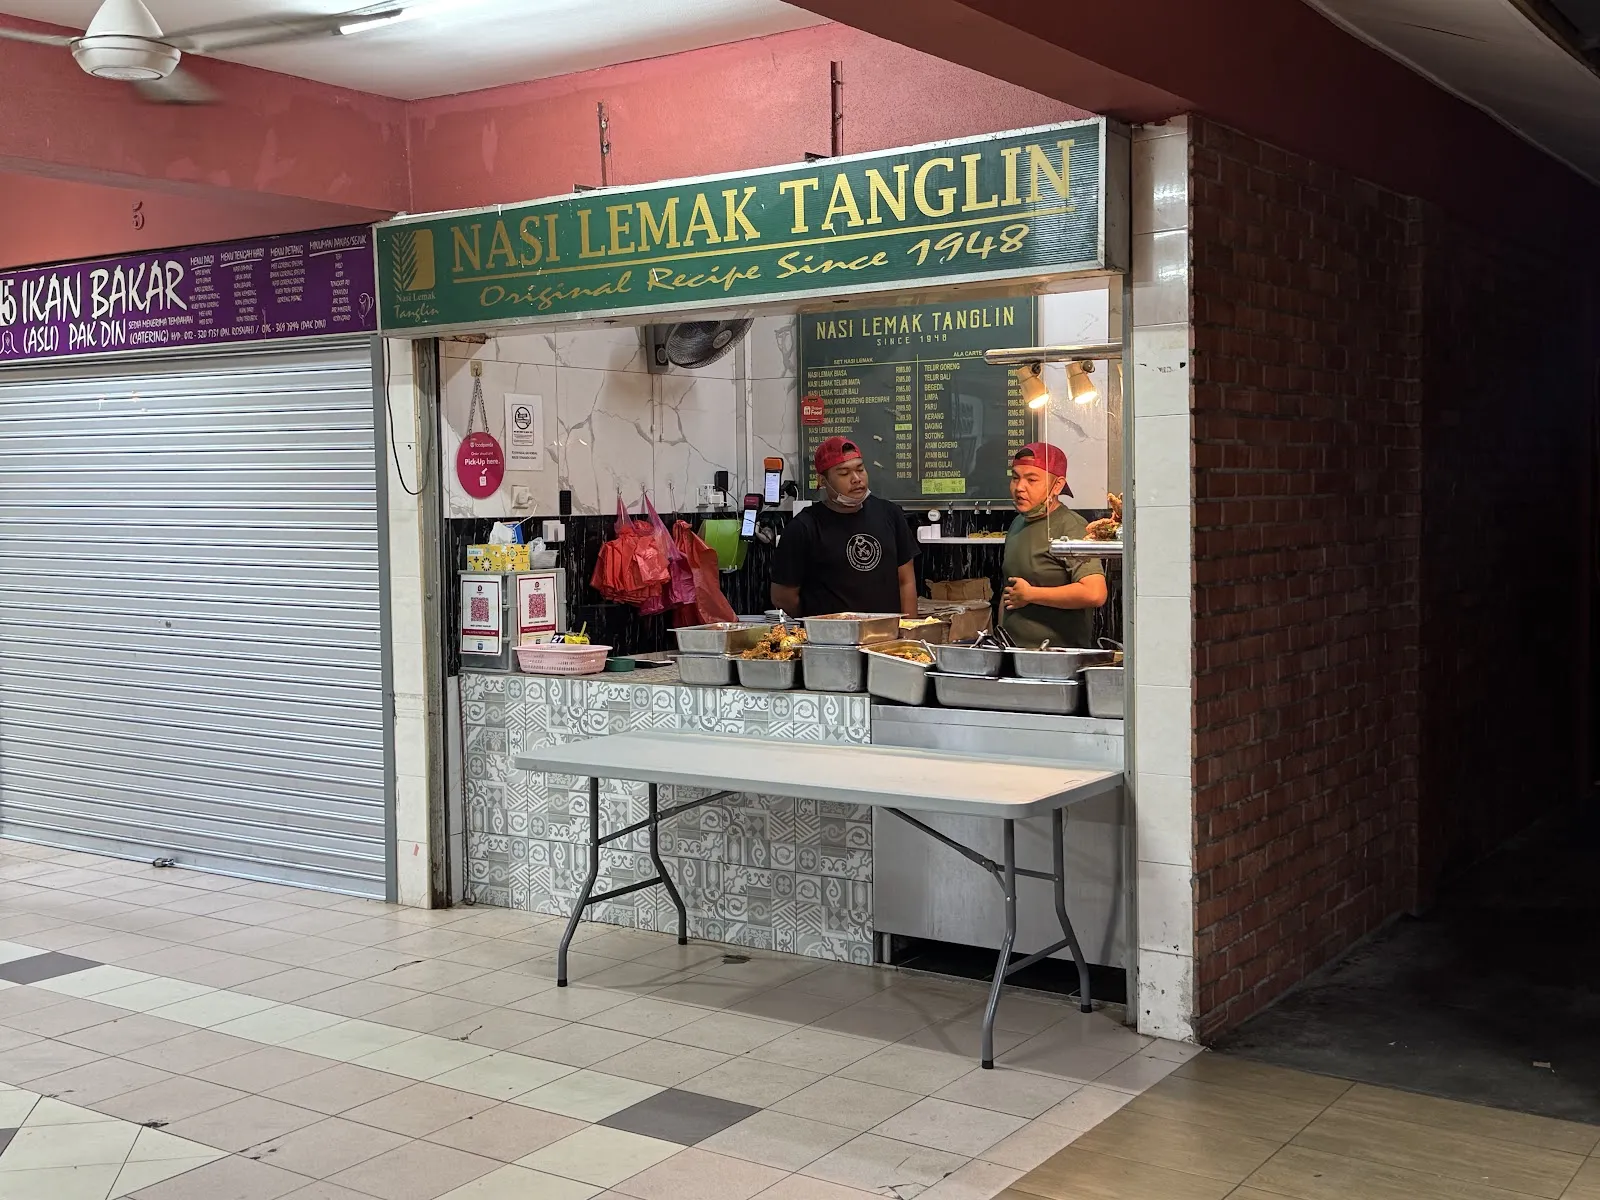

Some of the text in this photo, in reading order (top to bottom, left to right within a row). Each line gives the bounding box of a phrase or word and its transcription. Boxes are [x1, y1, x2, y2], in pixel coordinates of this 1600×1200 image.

[451, 139, 1075, 273] NASI LEMAK TANGLIN
[220, 252, 234, 261] MENU
[270, 247, 285, 257] MENU
[190, 256, 204, 266] MENU
[480, 223, 1030, 311] Original Recipe Since 1948
[22, 271, 81, 324] IKAN
[90, 260, 187, 319] BAKAR
[396, 291, 436, 302] Nasi Lemak
[393, 304, 440, 323] Tanglin
[816, 306, 1015, 340] NASI LEMAK TANGLIN
[23, 318, 126, 354] (ASLI) PAK DIN
[129, 329, 169, 345] (CATERING)
[876, 333, 948, 346] SINCE 1948
[924, 362, 960, 372] TELUR GORENG
[818, 370, 834, 378] LEMAK
[834, 369, 848, 377] BIASA
[940, 373, 951, 381] BALI
[834, 379, 848, 387] TELUR
[848, 378, 861, 386] MATA
[834, 388, 848, 396] TELUR
[865, 395, 890, 404] BEREMPAH
[924, 393, 938, 401] LIMPA
[924, 403, 938, 411] PARU
[924, 412, 944, 420] KERANG
[819, 426, 834, 434] LEMAK
[834, 425, 853, 433] BEGEDIL
[924, 422, 943, 430] DAGING
[924, 432, 944, 440] SOTONG
[924, 441, 958, 449] AYAM GORENG
[924, 451, 949, 459] AYAM BALI
[464, 458, 485, 467] Pick-Up
[924, 460, 952, 469] AYAM GULAI
[938, 470, 961, 478] RENDANG
[552, 635, 565, 643] 27
